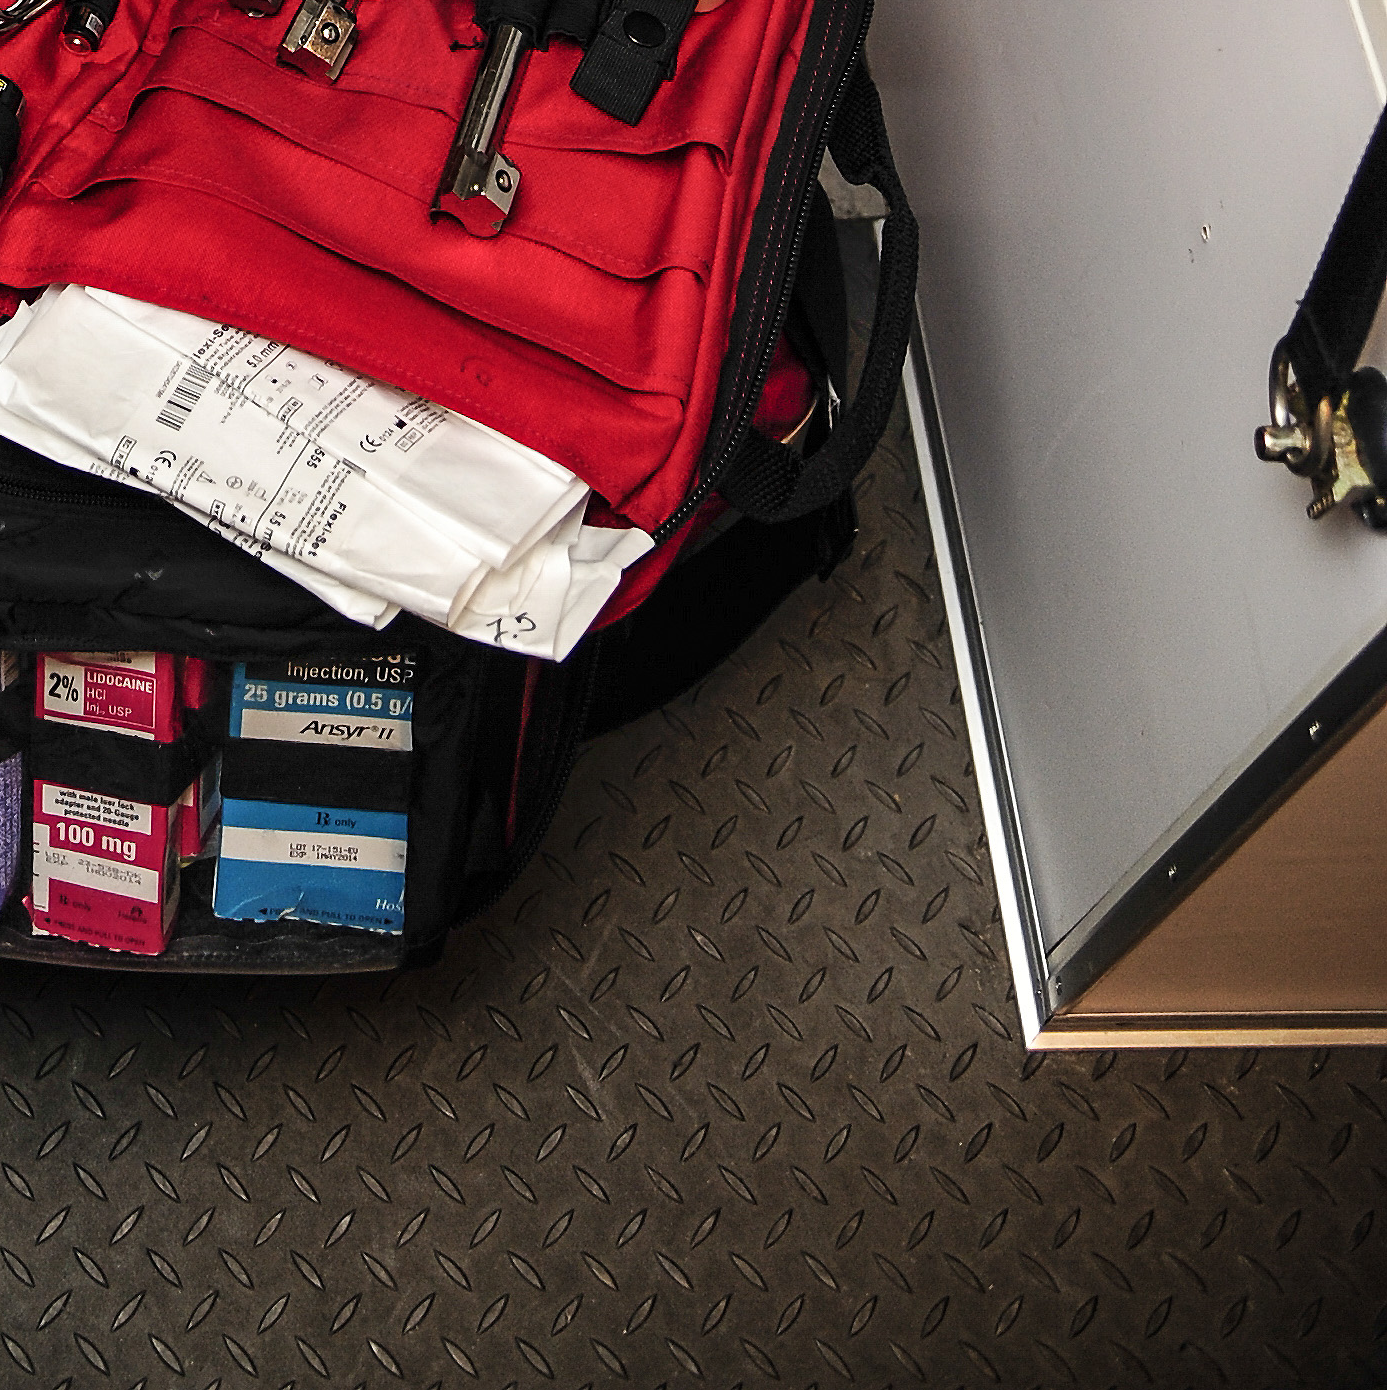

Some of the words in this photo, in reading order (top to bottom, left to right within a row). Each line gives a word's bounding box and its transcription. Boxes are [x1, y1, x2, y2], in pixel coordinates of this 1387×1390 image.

[308, 500, 348, 557] Flexi-Set
[86, 671, 153, 694] LIDOCAINE
[287, 661, 370, 684] Injection,
[376, 666, 414, 684] USP
[48, 671, 79, 703] 2%
[243, 683, 268, 702] 25
[274, 689, 340, 708] grams
[345, 690, 383, 710] (0.5
[108, 705, 133, 718] USP
[54, 798, 84, 810] adapter
[86, 802, 101, 812] and
[102, 806, 140, 822] 20-Gauge
[59, 789, 78, 800] with
[79, 793, 99, 804] male
[100, 796, 116, 808] luer
[117, 799, 135, 812] lock
[63, 808, 101, 822] protected
[102, 816, 130, 828] needle
[334, 818, 357, 829] only
[55, 821, 95, 847] 100
[101, 835, 137, 861] mg
[289, 843, 307, 852] LOT
[289, 851, 307, 859] EXP
[320, 910, 341, 920] PULL
[344, 912, 355, 921] TO
[358, 914, 383, 925] OPEN
